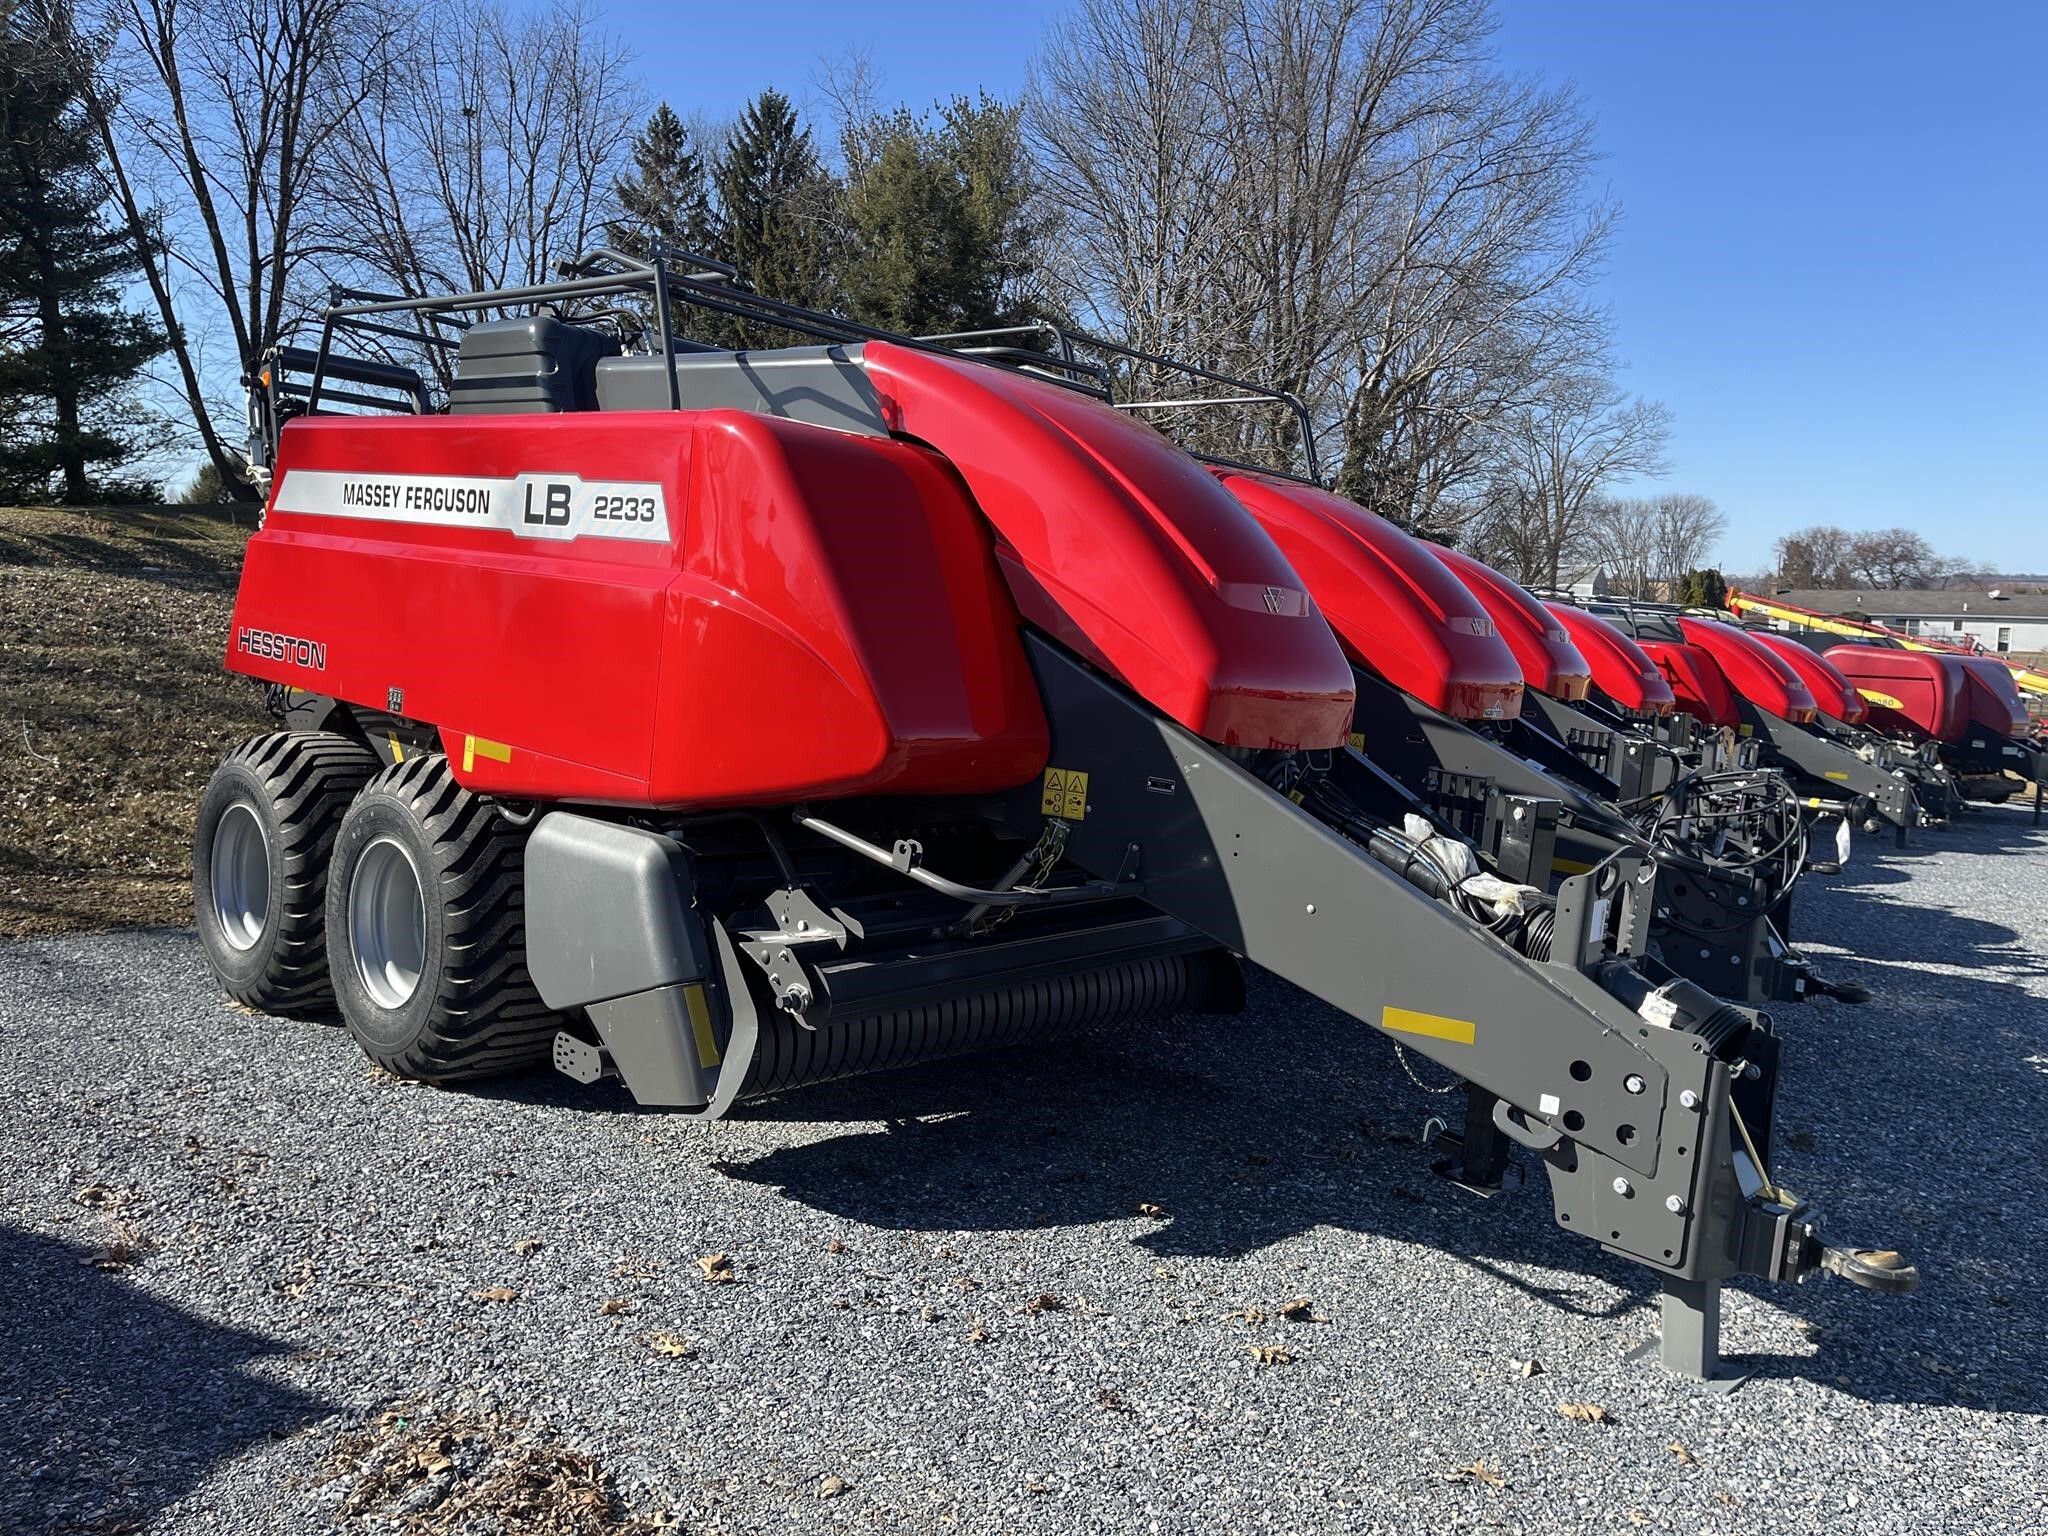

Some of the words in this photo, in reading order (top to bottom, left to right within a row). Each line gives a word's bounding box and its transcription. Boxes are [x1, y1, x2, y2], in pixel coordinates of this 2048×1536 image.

[343, 483, 401, 508] MASSEY
[405, 486, 490, 514] FERGUSON
[524, 483, 572, 526] LB
[594, 496, 656, 522] 2233
[238, 627, 326, 671] HESSTON
